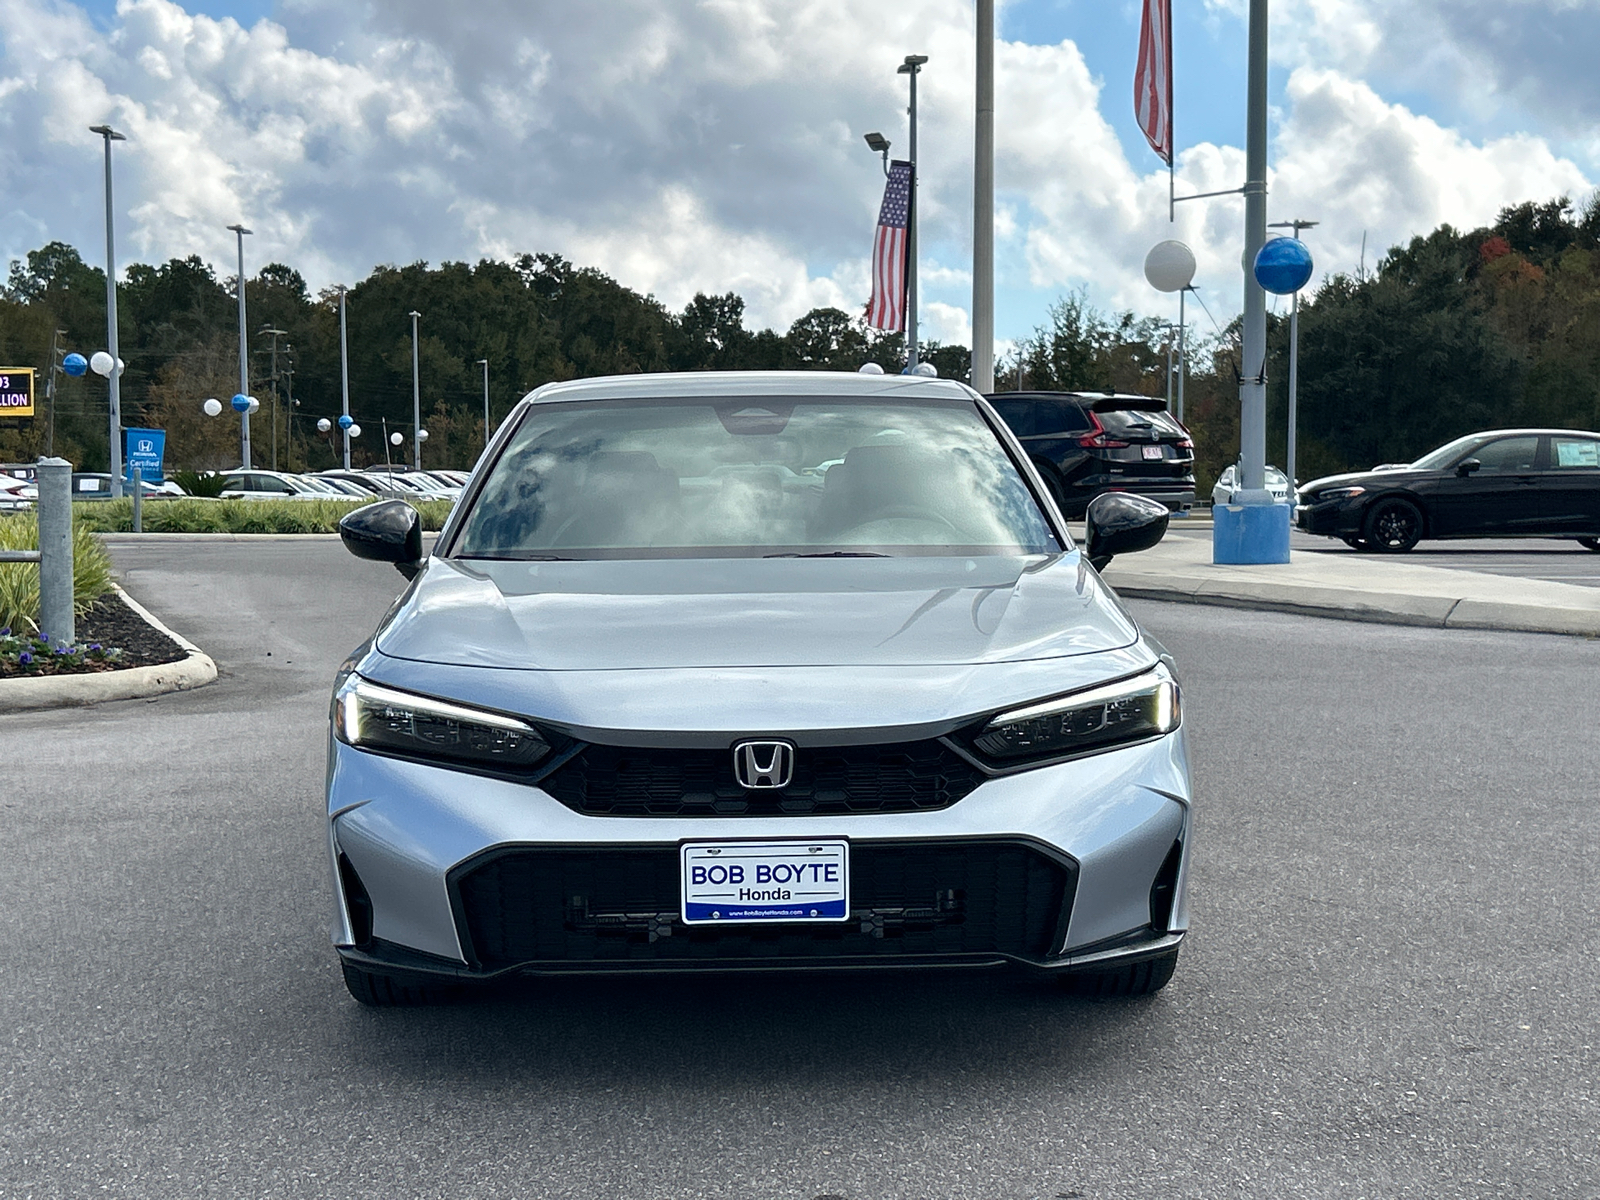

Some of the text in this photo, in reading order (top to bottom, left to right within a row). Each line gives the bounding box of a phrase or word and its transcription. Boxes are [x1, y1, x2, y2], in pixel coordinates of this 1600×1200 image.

[0, 394, 28, 406] LION
[130, 459, 160, 467] Certified
[691, 863, 839, 885] BOB BOYTE
[739, 887, 791, 901] Honda
